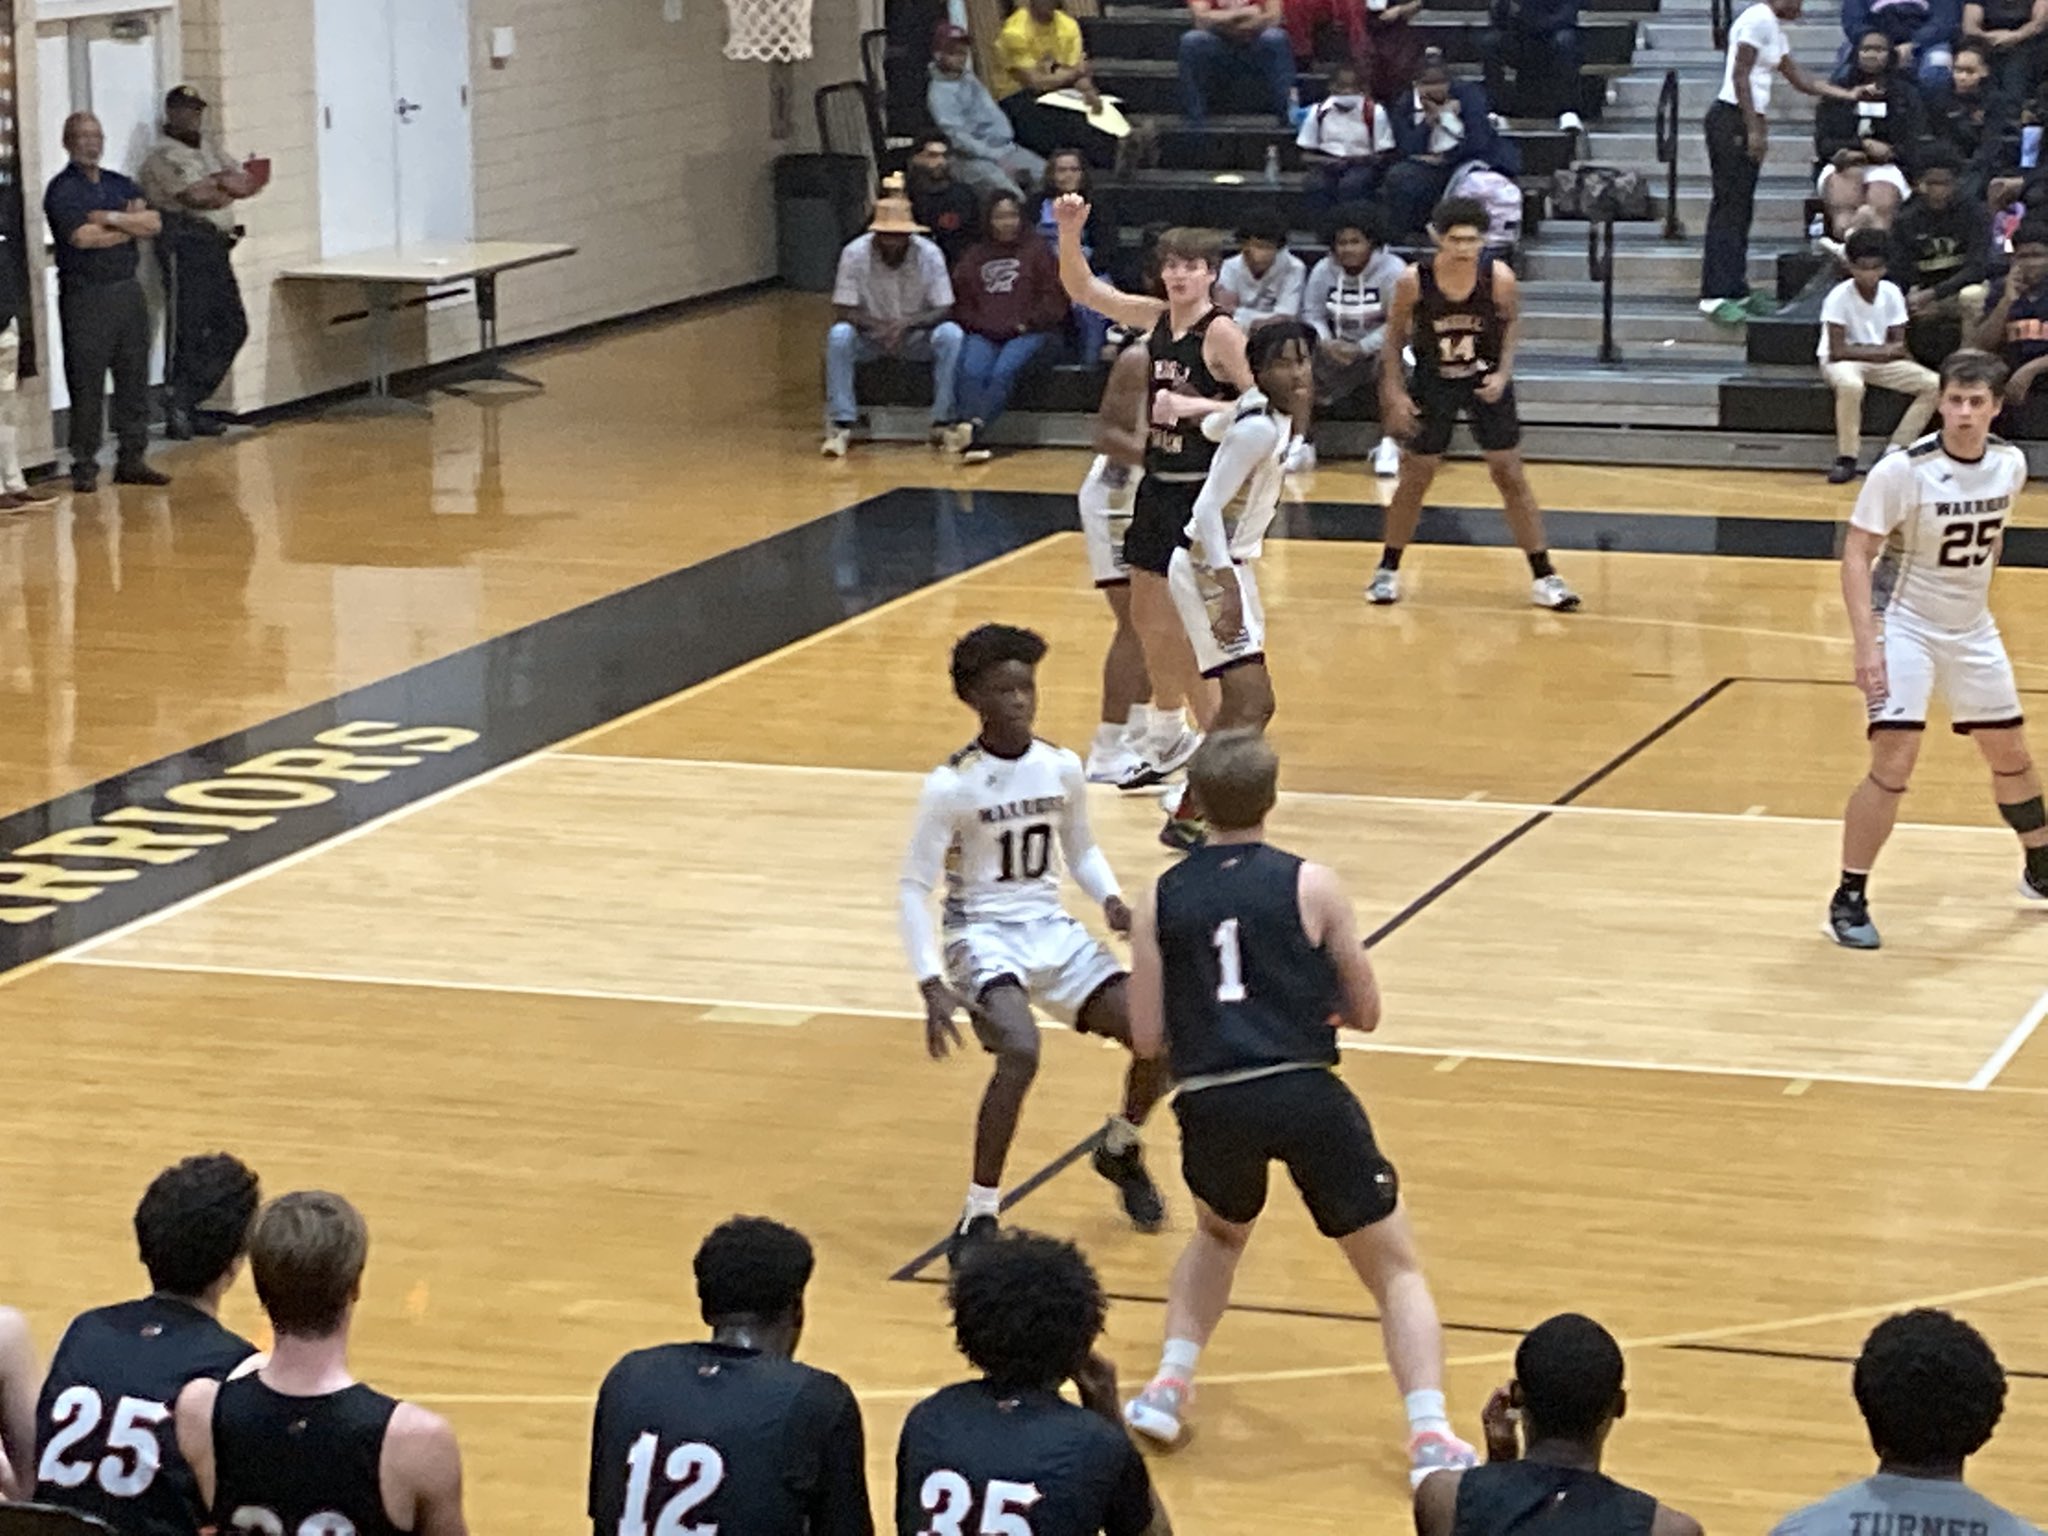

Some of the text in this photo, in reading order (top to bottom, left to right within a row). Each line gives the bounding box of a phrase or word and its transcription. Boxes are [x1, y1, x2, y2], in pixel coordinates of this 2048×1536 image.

[1439, 334, 1476, 361] 14
[1939, 517, 2004, 568] 25
[995, 823, 1051, 882] 10
[1212, 916, 1248, 1003] 1
[37, 1384, 174, 1497] 25
[617, 1430, 725, 1536] 12
[916, 1468, 1043, 1536] 35
